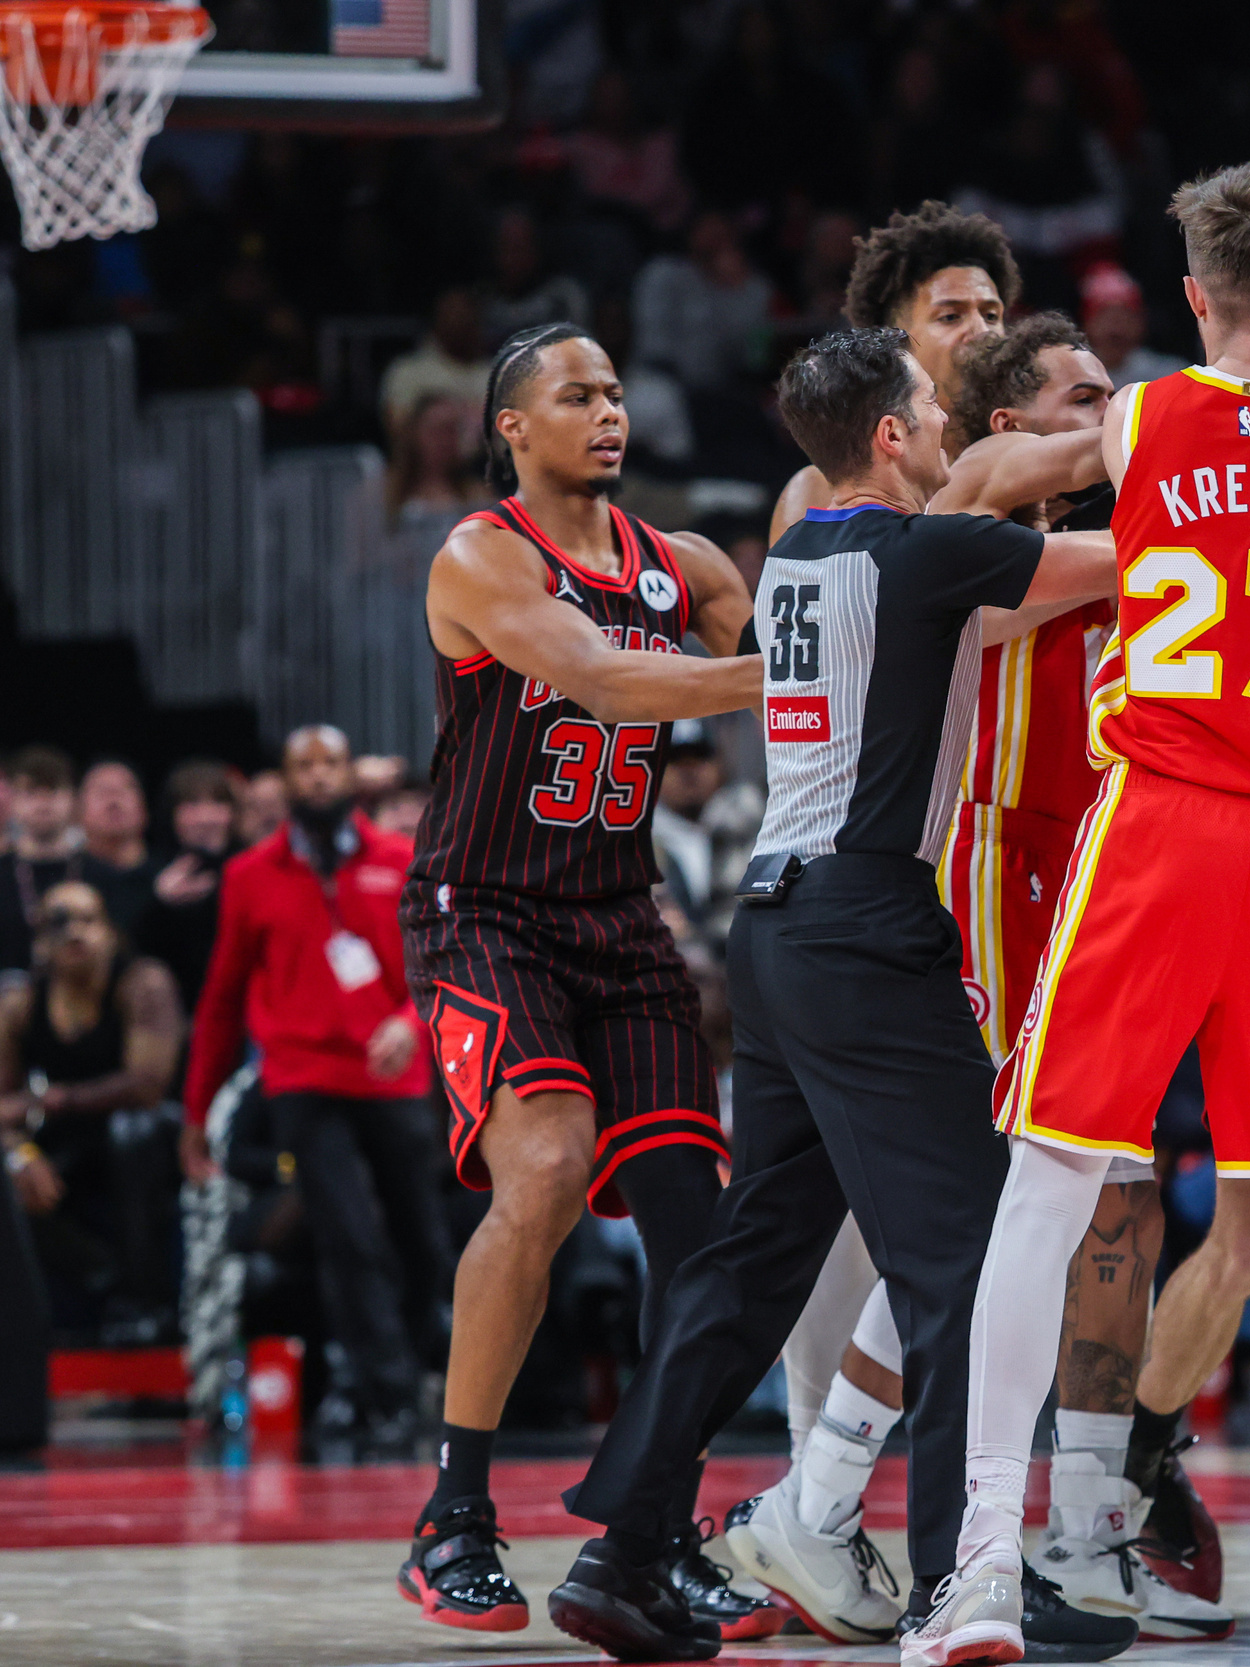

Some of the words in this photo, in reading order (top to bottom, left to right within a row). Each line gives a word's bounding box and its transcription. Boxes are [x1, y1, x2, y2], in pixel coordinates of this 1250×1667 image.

[769, 584, 821, 682] 35
[769, 706, 822, 730] Emirates
[529, 717, 660, 831] 35
